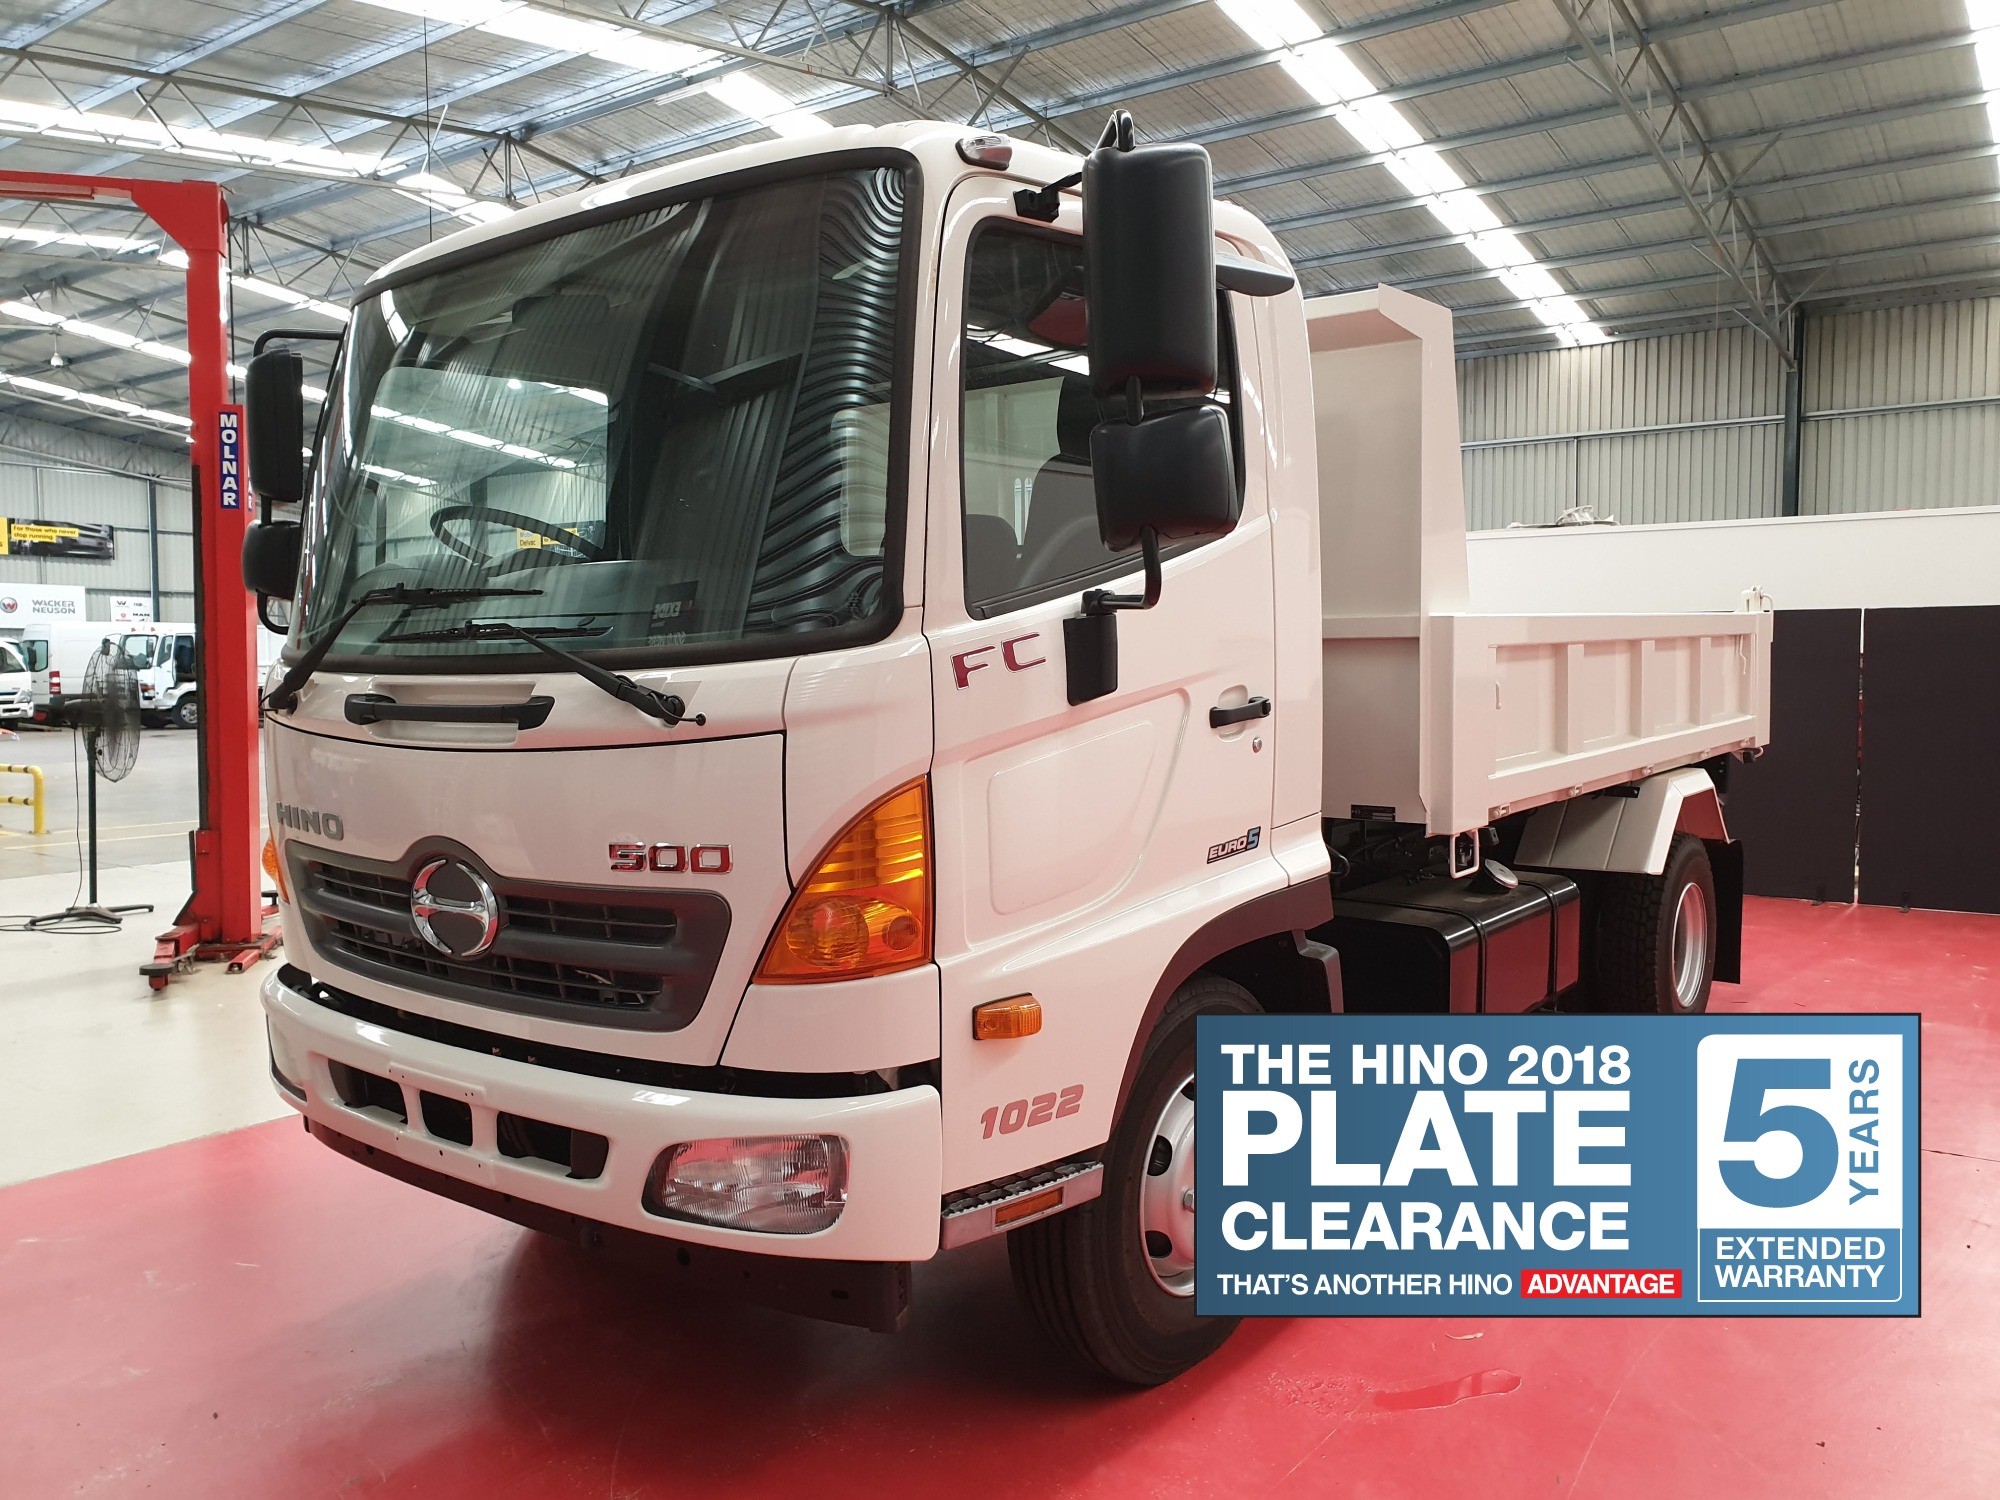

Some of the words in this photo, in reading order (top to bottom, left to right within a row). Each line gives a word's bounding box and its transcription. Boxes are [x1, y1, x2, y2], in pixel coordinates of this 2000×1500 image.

[220, 413, 238, 506] MOLNAR
[32, 599, 75, 607] WACKER
[32, 606, 76, 614] NEUSON
[950, 632, 1046, 691] FC
[276, 802, 345, 841] HINO
[608, 840, 734, 875] 500
[980, 1084, 1084, 1140] 1022
